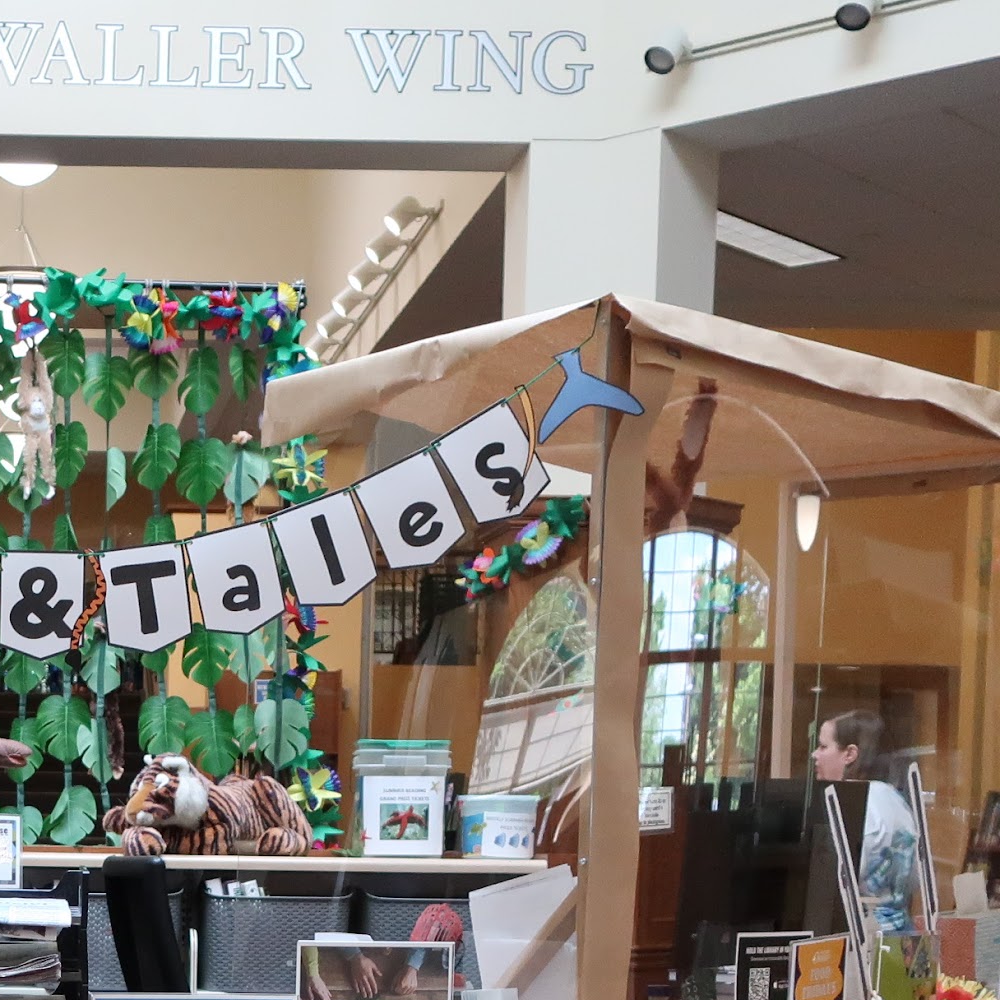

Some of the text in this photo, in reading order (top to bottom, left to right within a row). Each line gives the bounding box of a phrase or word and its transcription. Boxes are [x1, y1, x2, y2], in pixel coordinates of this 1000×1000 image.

[345, 27, 595, 95] WING
[9, 566, 74, 639] &
[110, 441, 525, 636] Tales
